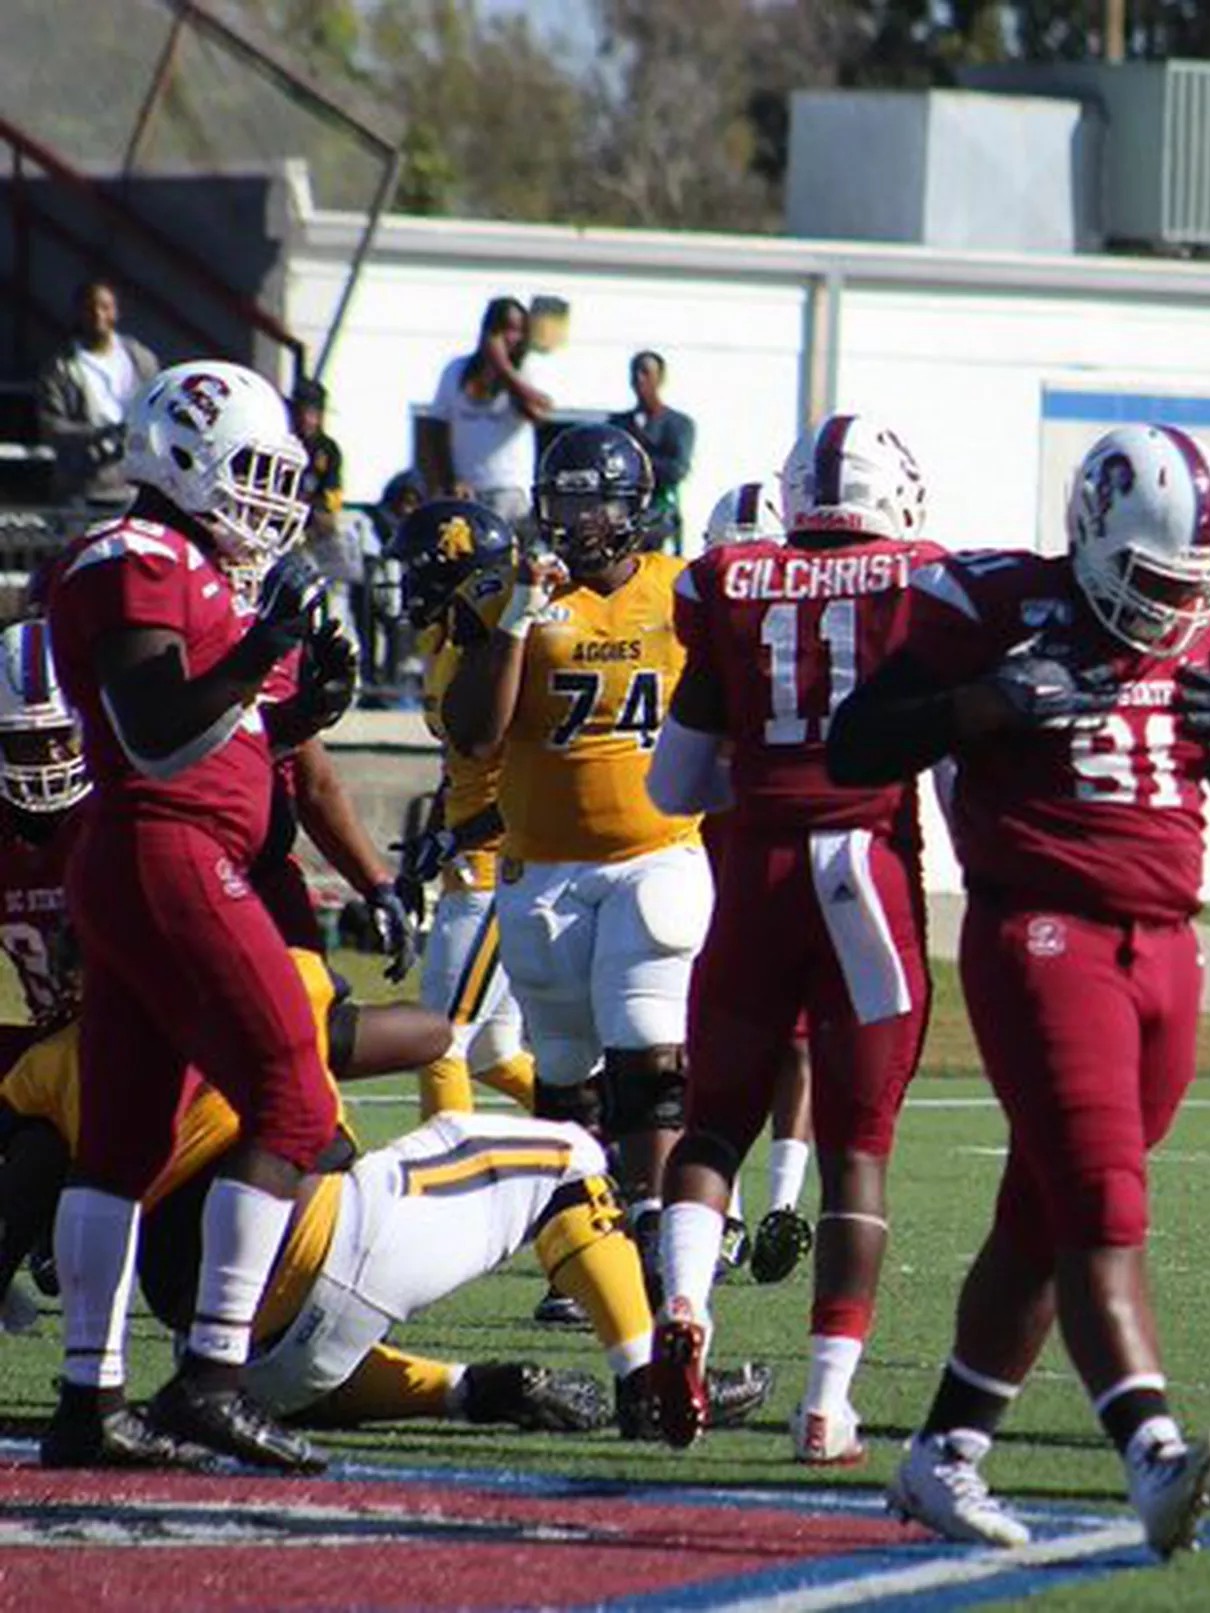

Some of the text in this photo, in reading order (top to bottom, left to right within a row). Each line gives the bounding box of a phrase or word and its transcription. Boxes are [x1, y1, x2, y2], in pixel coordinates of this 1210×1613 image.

[723, 551, 917, 601] GILCHRIST
[572, 639, 642, 663] AGGIES
[760, 600, 856, 746] 11
[551, 669, 664, 752] 74
[1070, 713, 1184, 808] 91
